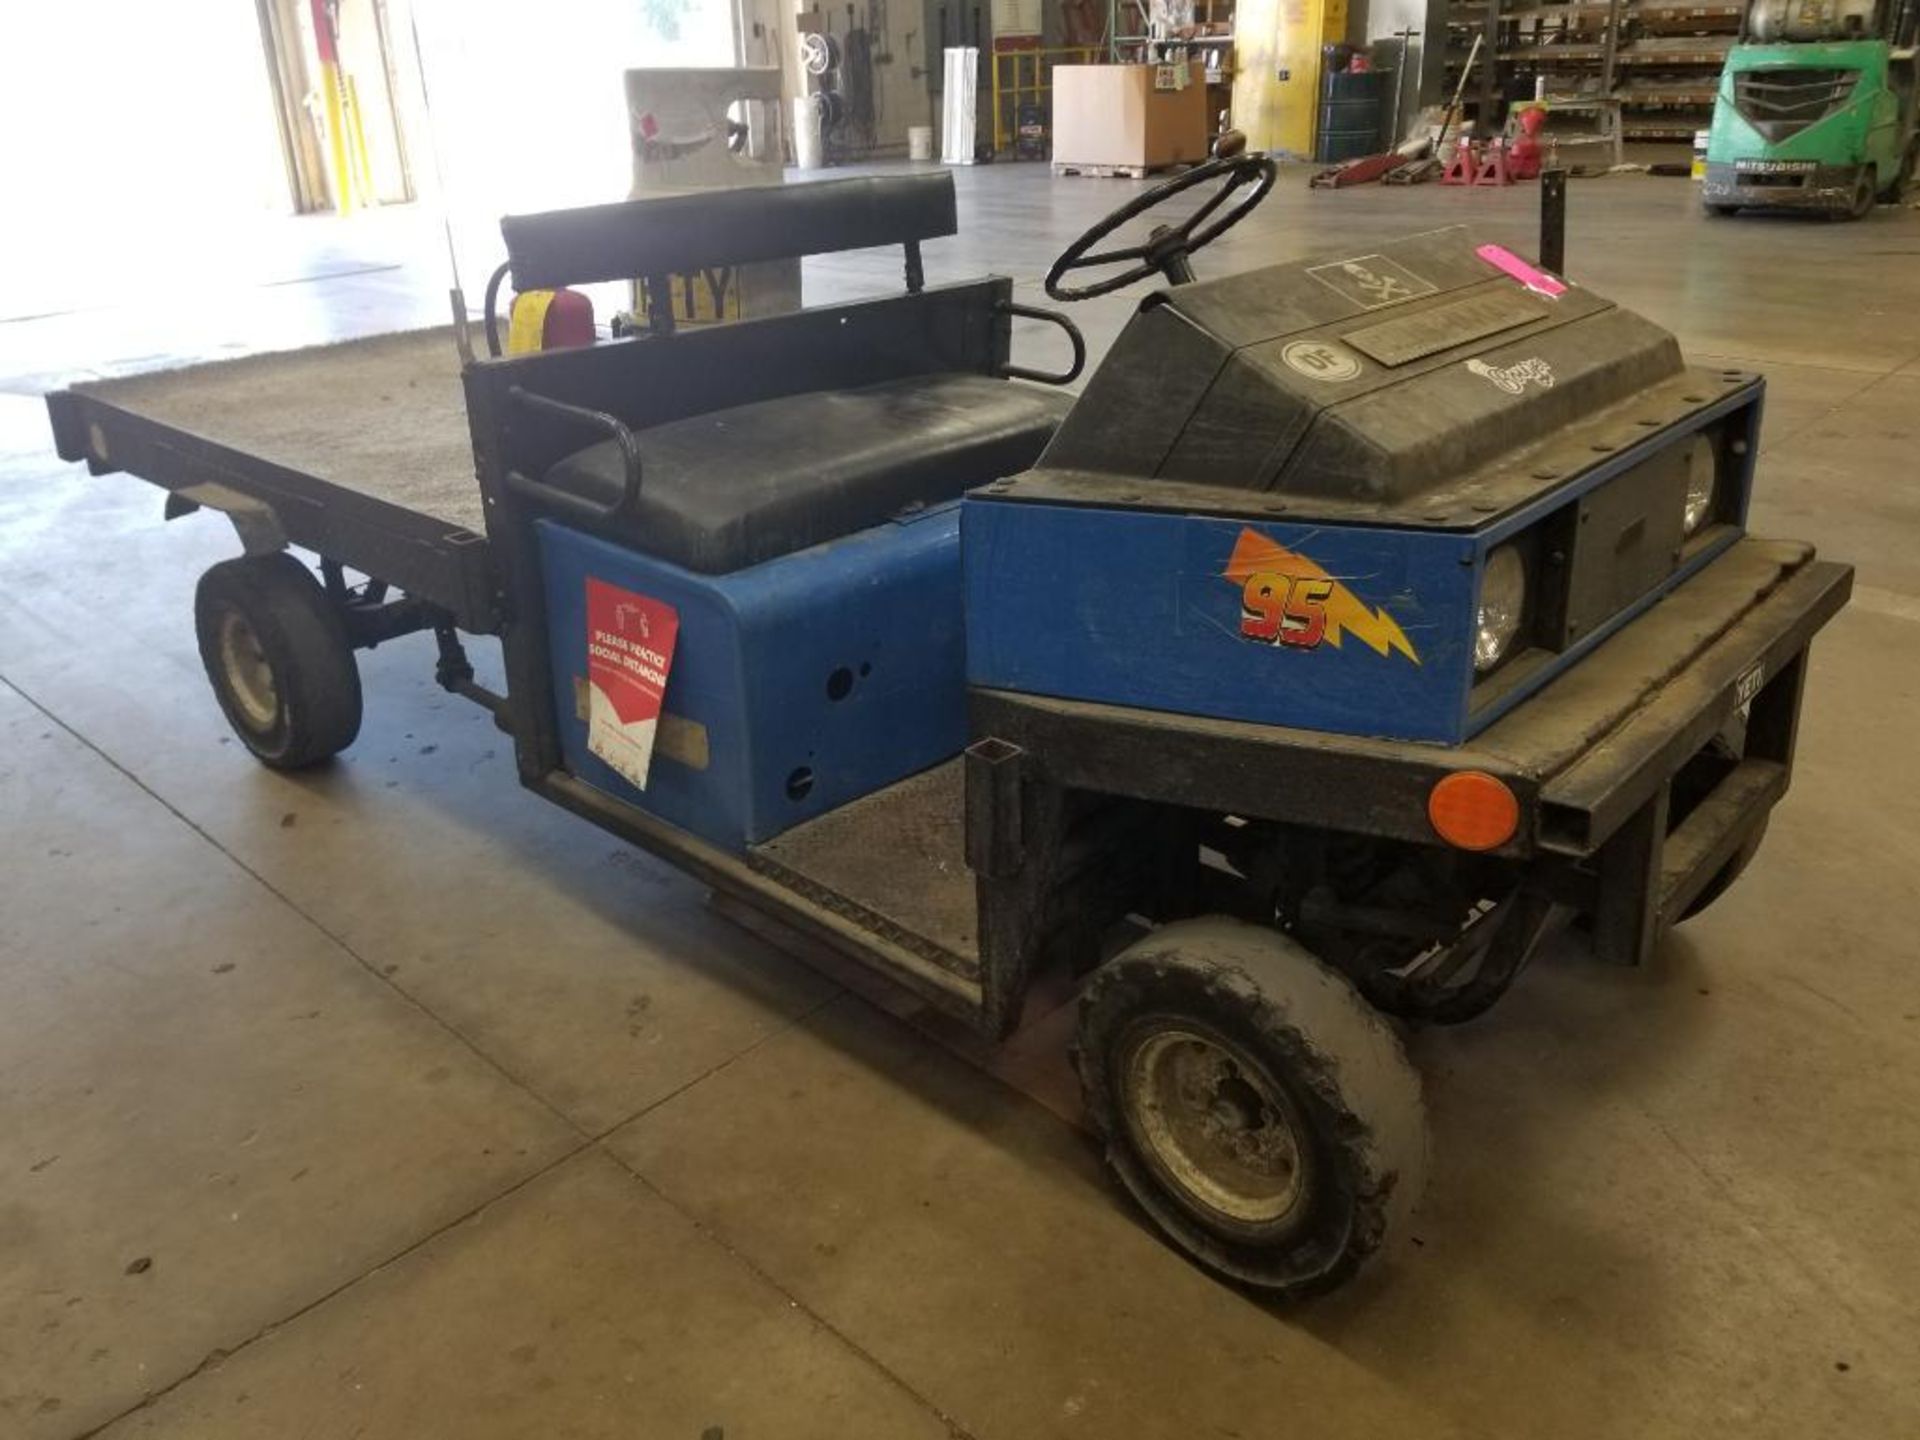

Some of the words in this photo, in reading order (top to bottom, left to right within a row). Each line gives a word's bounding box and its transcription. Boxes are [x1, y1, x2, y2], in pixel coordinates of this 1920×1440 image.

[1735, 161, 1817, 172] MITSUBISHI
[1297, 348, 1340, 371] DF
[1240, 571, 1334, 652] 95
[589, 643, 623, 664] SOCIAL
[595, 630, 628, 651] PLEASE
[628, 642, 666, 668] PRACTICE
